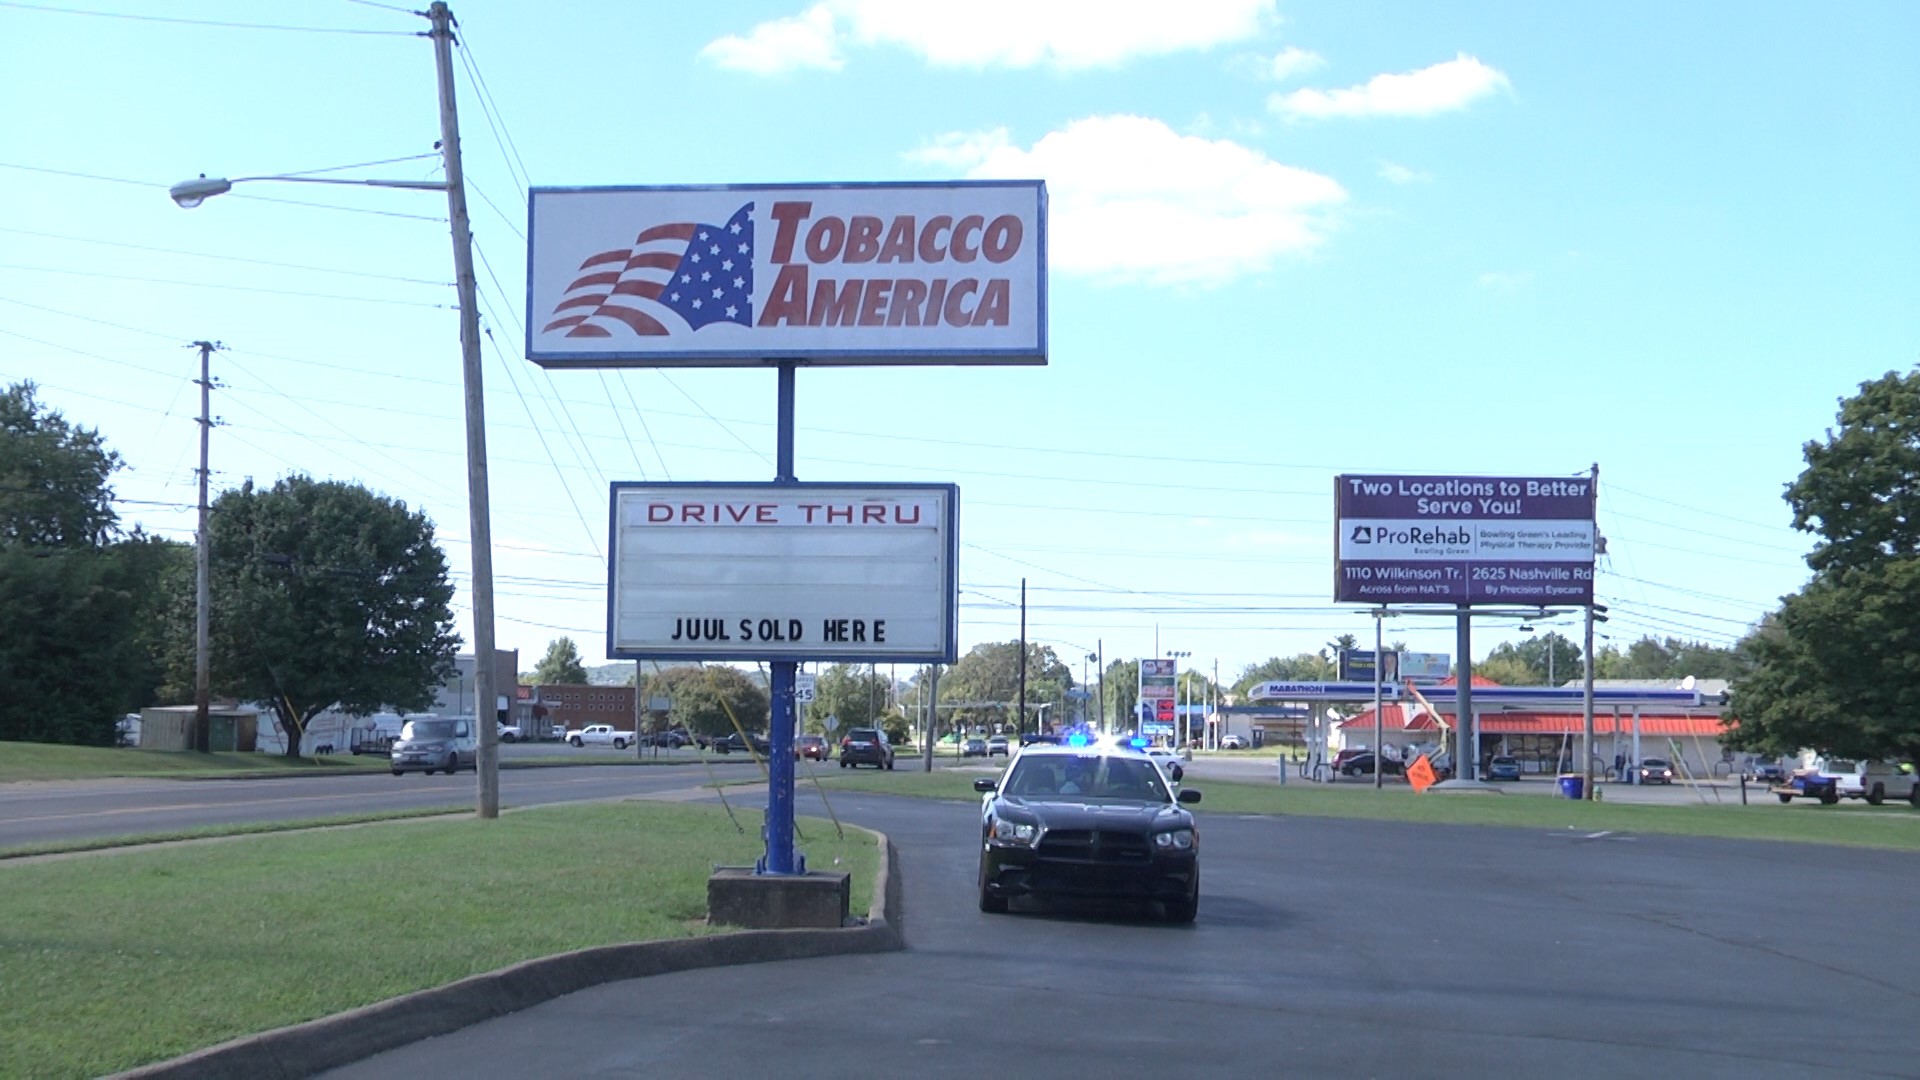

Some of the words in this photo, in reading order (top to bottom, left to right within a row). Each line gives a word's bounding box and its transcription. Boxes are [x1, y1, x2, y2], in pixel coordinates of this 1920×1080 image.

[770, 201, 1023, 264] TOBACCO
[757, 265, 1010, 328] AMERICA
[1350, 479, 1392, 496] Two
[1399, 479, 1494, 496] Locations
[1500, 480, 1520, 496] to
[1527, 480, 1587, 496] Better
[1417, 498, 1473, 514] Serve
[1479, 499, 1521, 514] You!
[648, 504, 779, 523] DRIVE
[798, 505, 920, 524] THRU
[1377, 525, 1471, 544] ProRehab
[1480, 531, 1515, 539] Bowling
[1480, 541, 1515, 549] Physical
[1518, 541, 1552, 549] Therapy
[1555, 541, 1591, 549] Provider
[1345, 567, 1371, 580] 1110
[1375, 567, 1441, 580] Wilkinson
[1444, 567, 1463, 580] Tr.
[1472, 567, 1506, 580] 2625
[1509, 567, 1570, 580] Nashville
[1573, 567, 1592, 580] Rd
[1359, 585, 1392, 594] Across
[1394, 584, 1417, 594] from
[1485, 585, 1498, 595] By
[1500, 585, 1544, 594] Precision
[1545, 585, 1584, 595] Eyecare
[671, 618, 730, 641] JUUL
[740, 619, 803, 641] SOLD
[823, 619, 886, 642] HERE
[796, 689, 813, 700] 45
